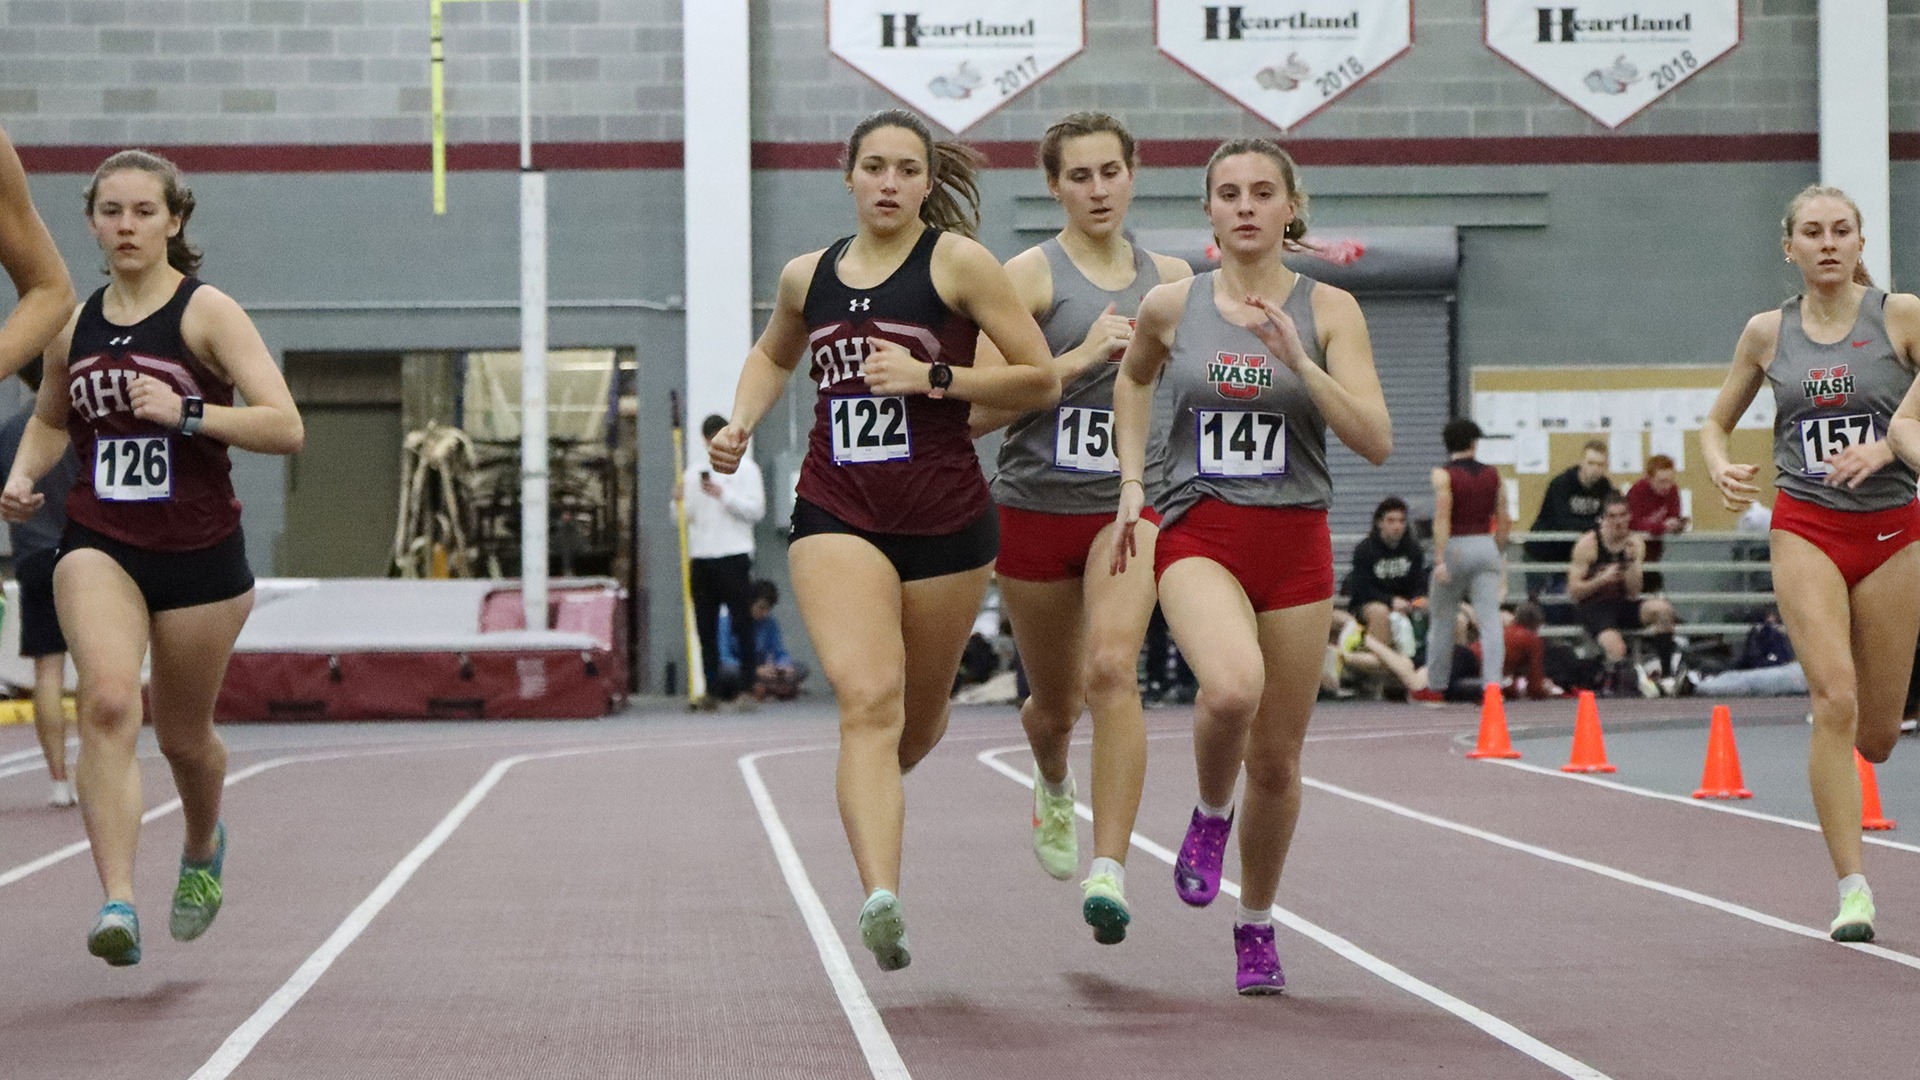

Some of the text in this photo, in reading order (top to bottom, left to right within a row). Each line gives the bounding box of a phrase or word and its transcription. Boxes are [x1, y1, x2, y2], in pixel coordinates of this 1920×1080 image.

[879, 13, 1034, 47] Heartland
[1203, 6, 1359, 40] Heartland
[1536, 7, 1691, 42] Heartland
[994, 55, 1038, 96] 2017
[1315, 55, 1364, 97] 2018
[1651, 50, 1698, 91] 2018
[1208, 363, 1273, 387] WASH
[1802, 376, 1855, 398] WASH
[834, 397, 907, 449] 122
[1062, 409, 1119, 459] 15
[1204, 412, 1284, 461] 147
[1806, 416, 1871, 462] 157
[100, 439, 168, 487] 126
